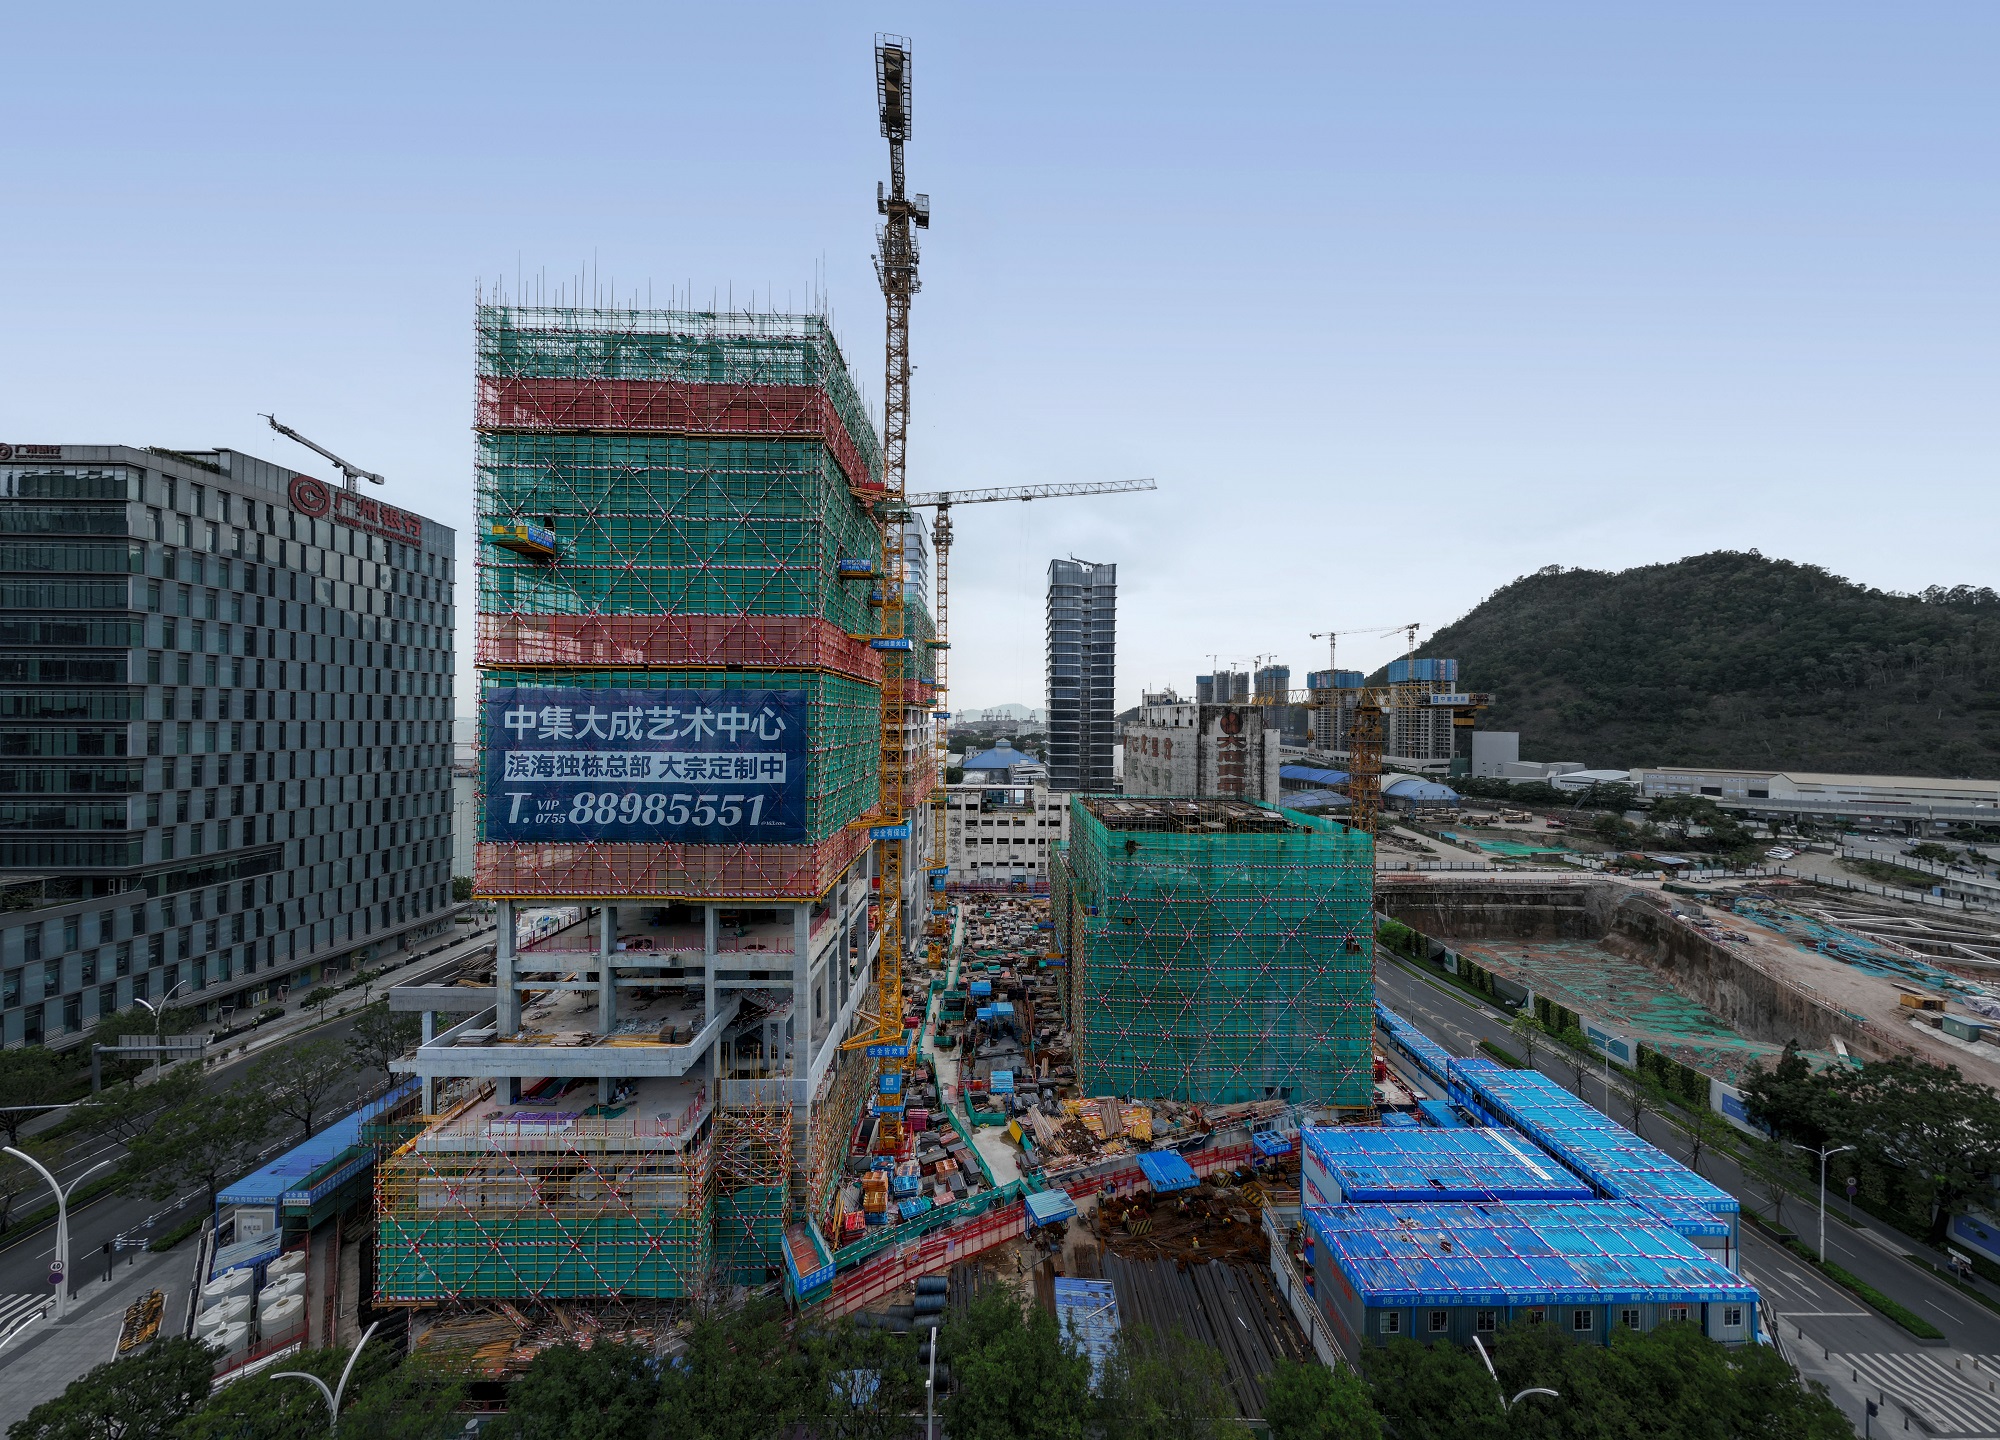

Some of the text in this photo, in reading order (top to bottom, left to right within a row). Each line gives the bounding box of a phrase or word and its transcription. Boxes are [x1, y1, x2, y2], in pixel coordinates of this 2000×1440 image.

[335, 491, 422, 536] 广州银行
[335, 514, 361, 528] BANK
[377, 527, 422, 547] GUANGZHOU
[505, 705, 787, 742] 中集大成艺术中心
[507, 754, 785, 780] 滨海独栋总部 大宗定制中
[504, 792, 560, 824] T. VIP
[535, 792, 765, 826] 0755 88985551
[872, 828, 907, 837] 安全有保证
[869, 1047, 905, 1056] 安全皆欢喜
[1676, 1226, 1697, 1235] 全生产
[1382, 1292, 1750, 1305] 倾心打造精品工程 努力提升企业品牌 精心组织 精细施工
